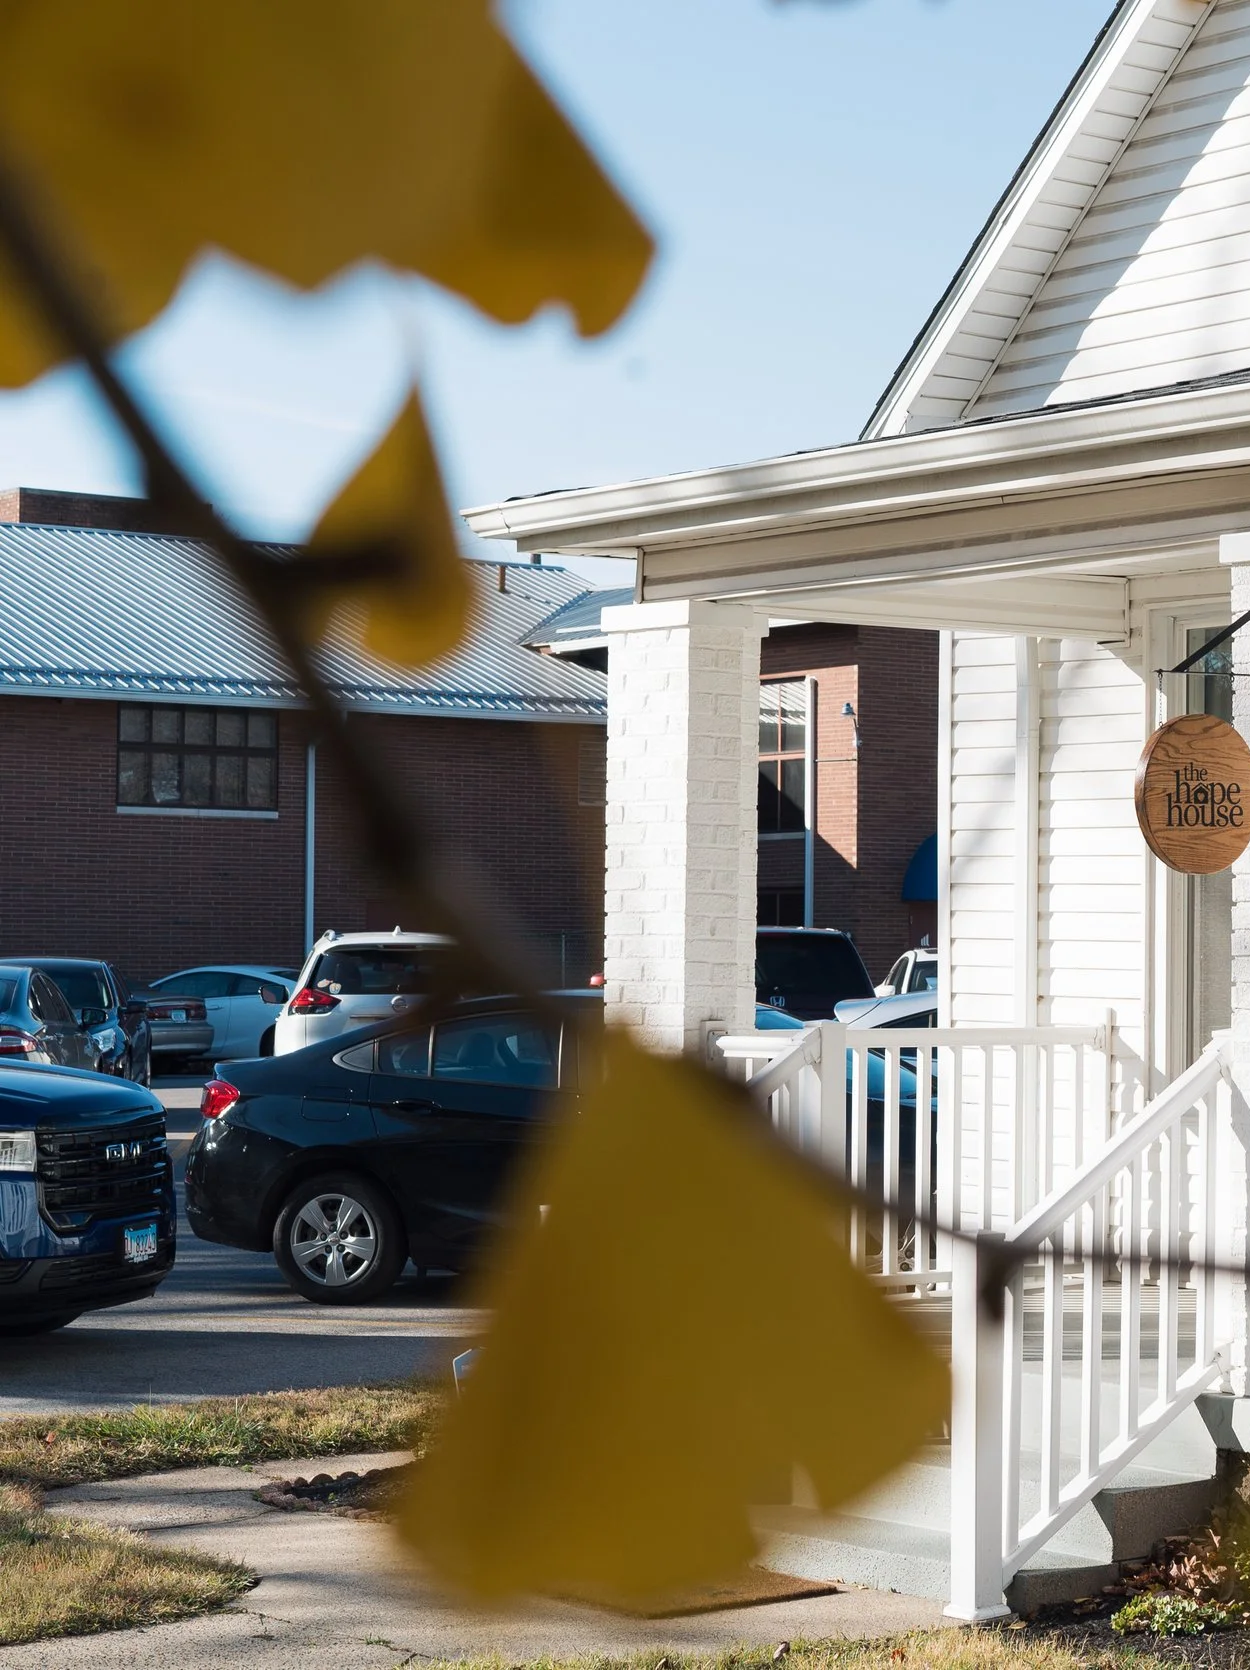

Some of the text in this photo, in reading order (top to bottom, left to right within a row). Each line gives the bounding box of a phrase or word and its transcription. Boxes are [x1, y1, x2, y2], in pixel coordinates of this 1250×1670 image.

[1184, 762, 1208, 781] the
[1165, 792, 1244, 828] house
[105, 1141, 147, 1161] GM
